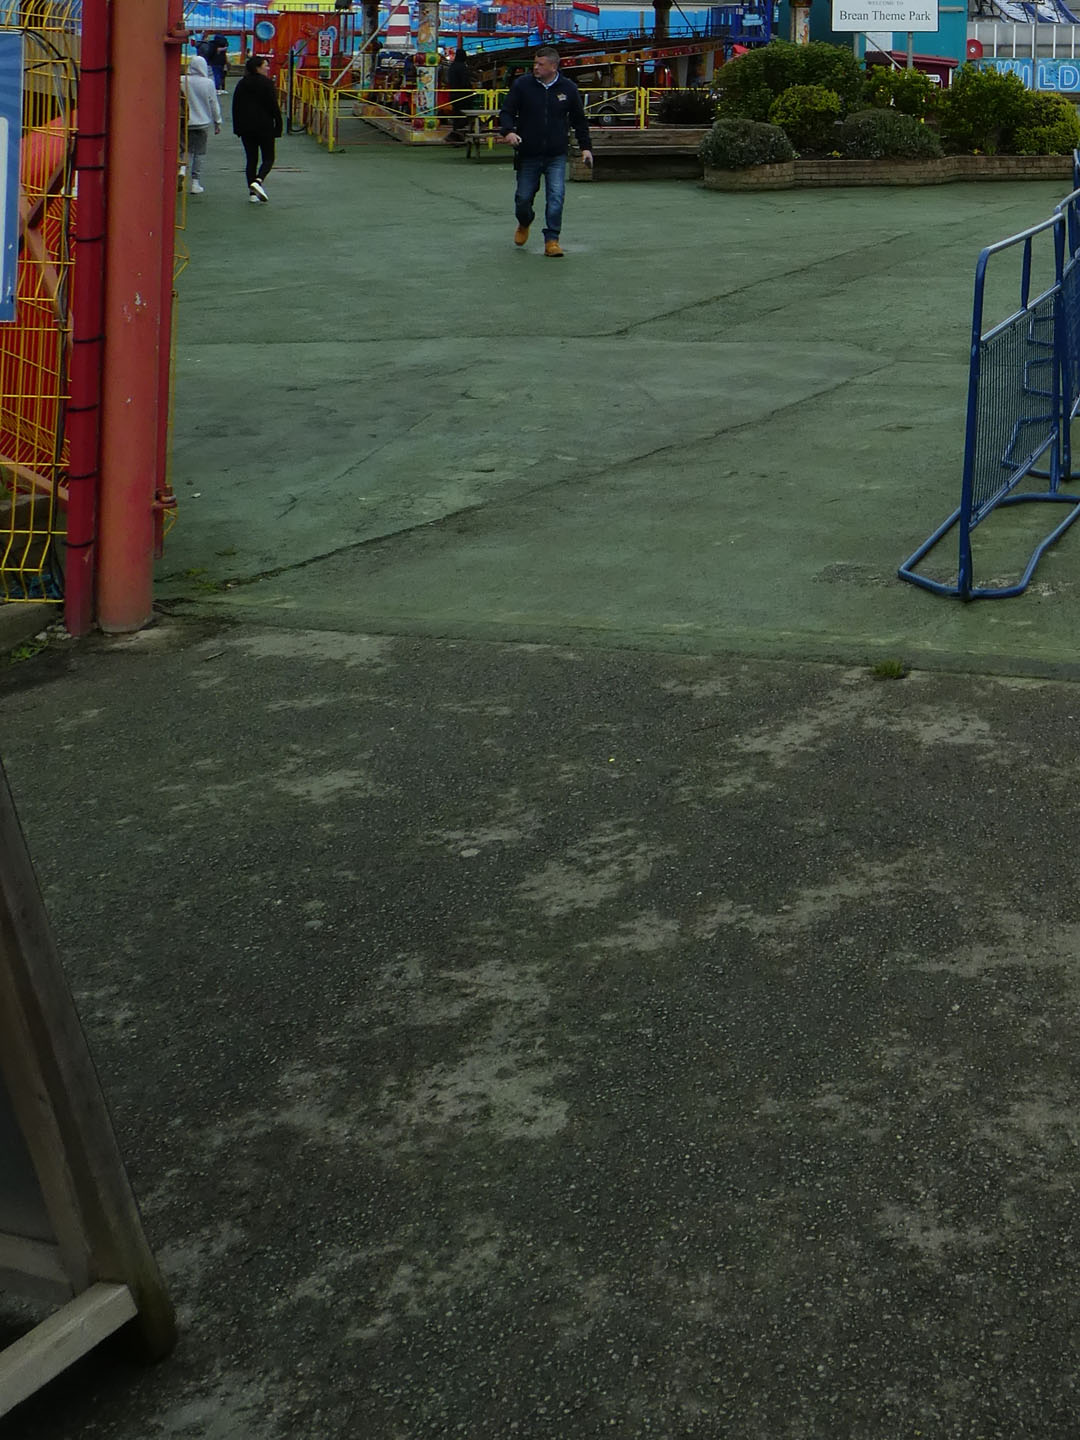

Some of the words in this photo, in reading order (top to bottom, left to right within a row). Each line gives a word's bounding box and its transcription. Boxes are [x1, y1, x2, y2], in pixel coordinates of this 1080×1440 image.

[840, 10, 869, 21] Brean
[872, 10, 906, 21] Theme
[909, 10, 931, 21] Park
[996, 60, 1080, 91] WILD
